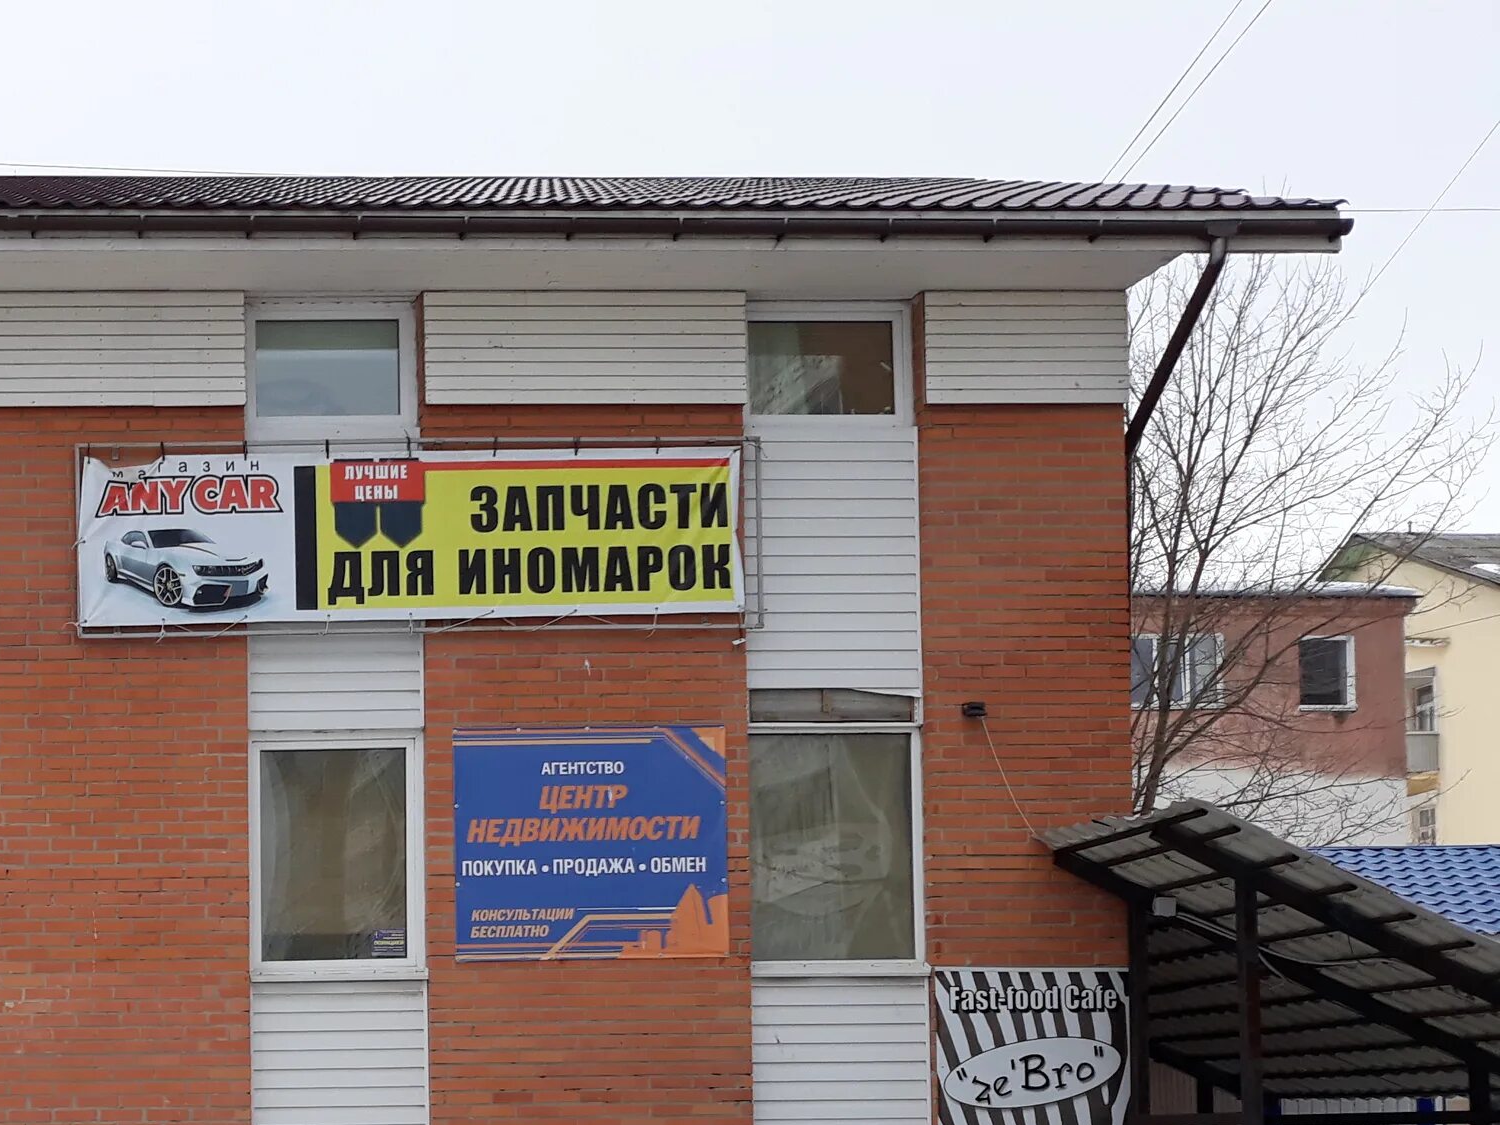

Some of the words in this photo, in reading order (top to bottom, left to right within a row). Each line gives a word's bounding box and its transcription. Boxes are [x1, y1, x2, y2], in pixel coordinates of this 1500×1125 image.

[111, 460, 260, 479] магазин
[344, 464, 408, 480] ЛУЧШИЕ
[95, 476, 195, 518] ANY
[190, 474, 283, 516] CAR
[354, 484, 399, 501] ЦЕНЫ
[470, 482, 729, 533] ЗАПЧАСТИ
[328, 550, 435, 605] ДЛЯ
[458, 543, 732, 595] ИНОМАРОК
[541, 761, 625, 775] АГЕНТСТВО
[539, 785, 628, 813] ЦЕНТР
[467, 816, 700, 847] НЕДВИЖИМОСТИ
[461, 859, 537, 876] ПОКУПКА
[553, 858, 635, 876] ПРОДАЖА
[650, 857, 707, 873] ОБМЕН
[471, 907, 575, 922] КОНСУЛЬТАЦИИ
[470, 924, 550, 939] БЕСПЛАТНО
[949, 985, 1060, 1013] Fast-food
[1065, 985, 1118, 1013] Cafe
